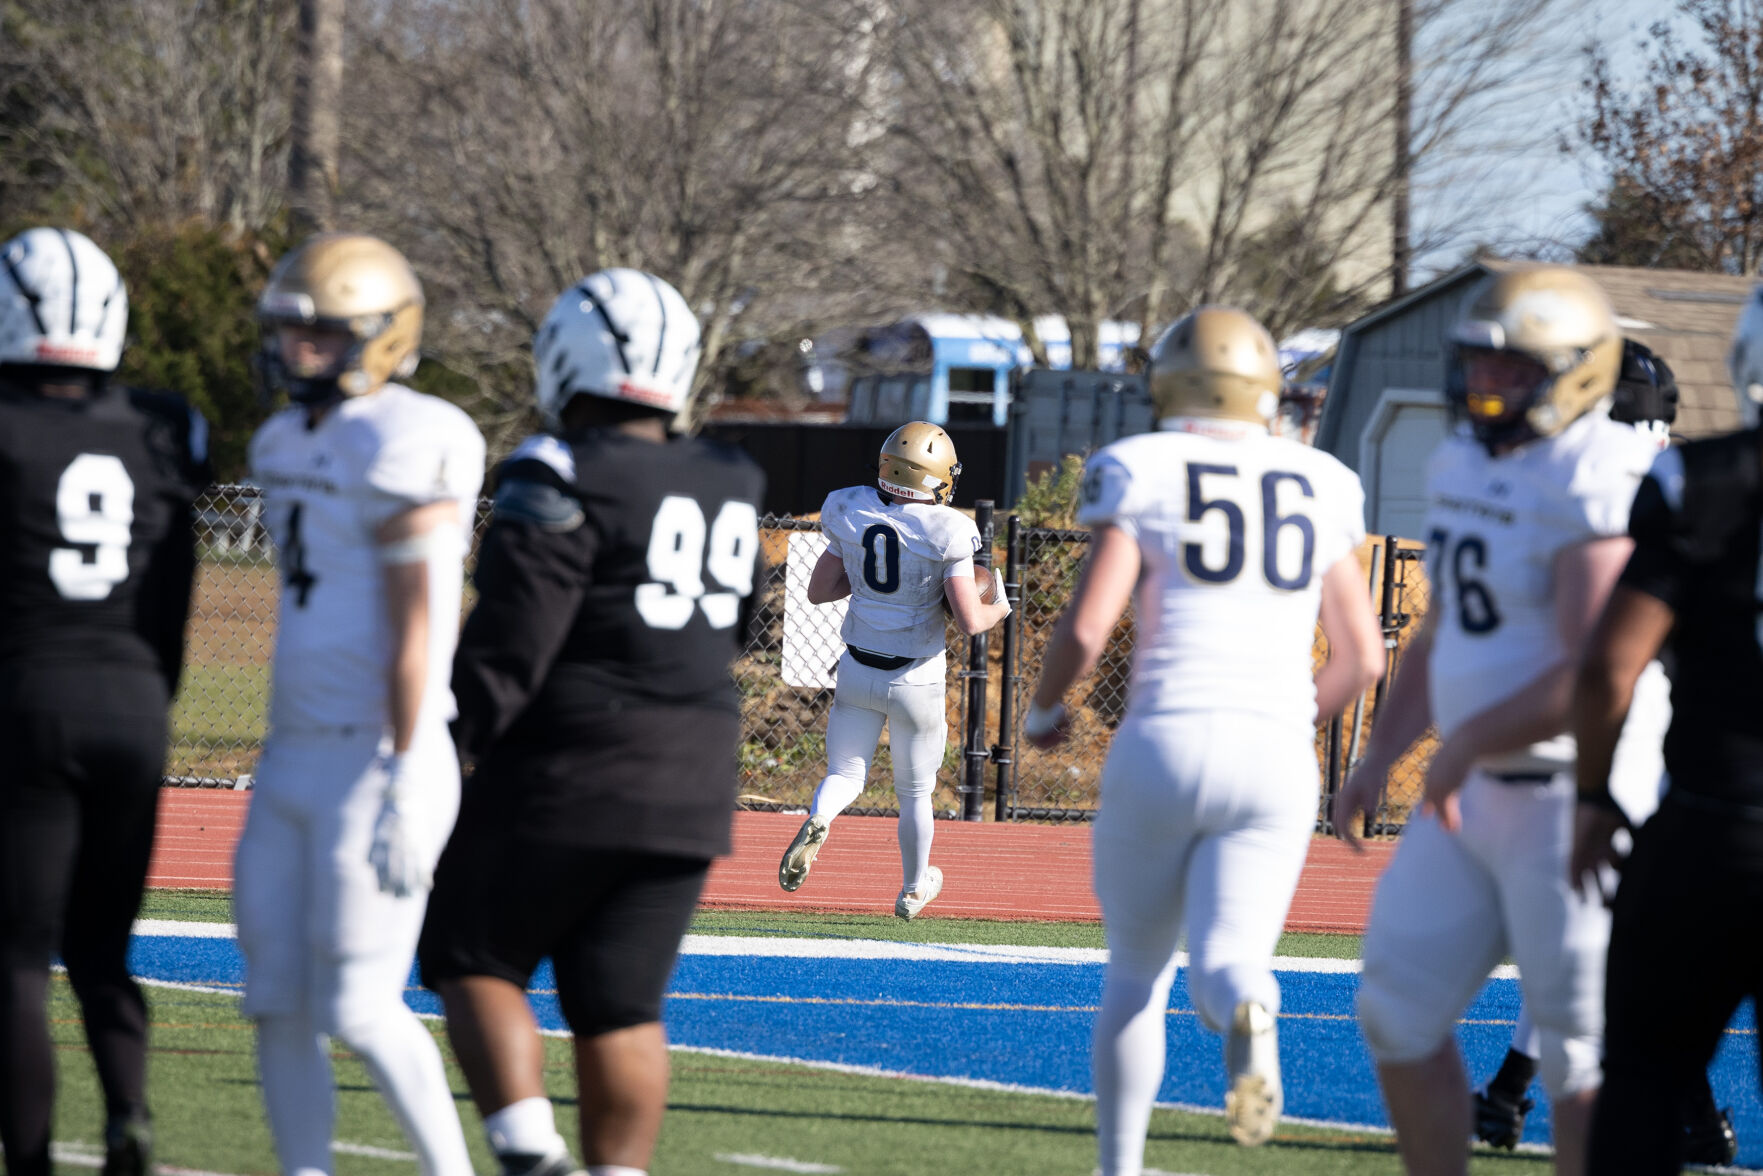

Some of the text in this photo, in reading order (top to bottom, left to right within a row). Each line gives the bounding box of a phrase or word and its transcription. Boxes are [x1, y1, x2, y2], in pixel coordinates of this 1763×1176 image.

[49, 453, 134, 600] 9
[881, 481, 914, 497] Riddell
[1184, 461, 1315, 592] 56
[281, 500, 318, 609] 4
[635, 496, 760, 630] 99
[862, 523, 900, 594] 0
[1429, 526, 1502, 635] 76
